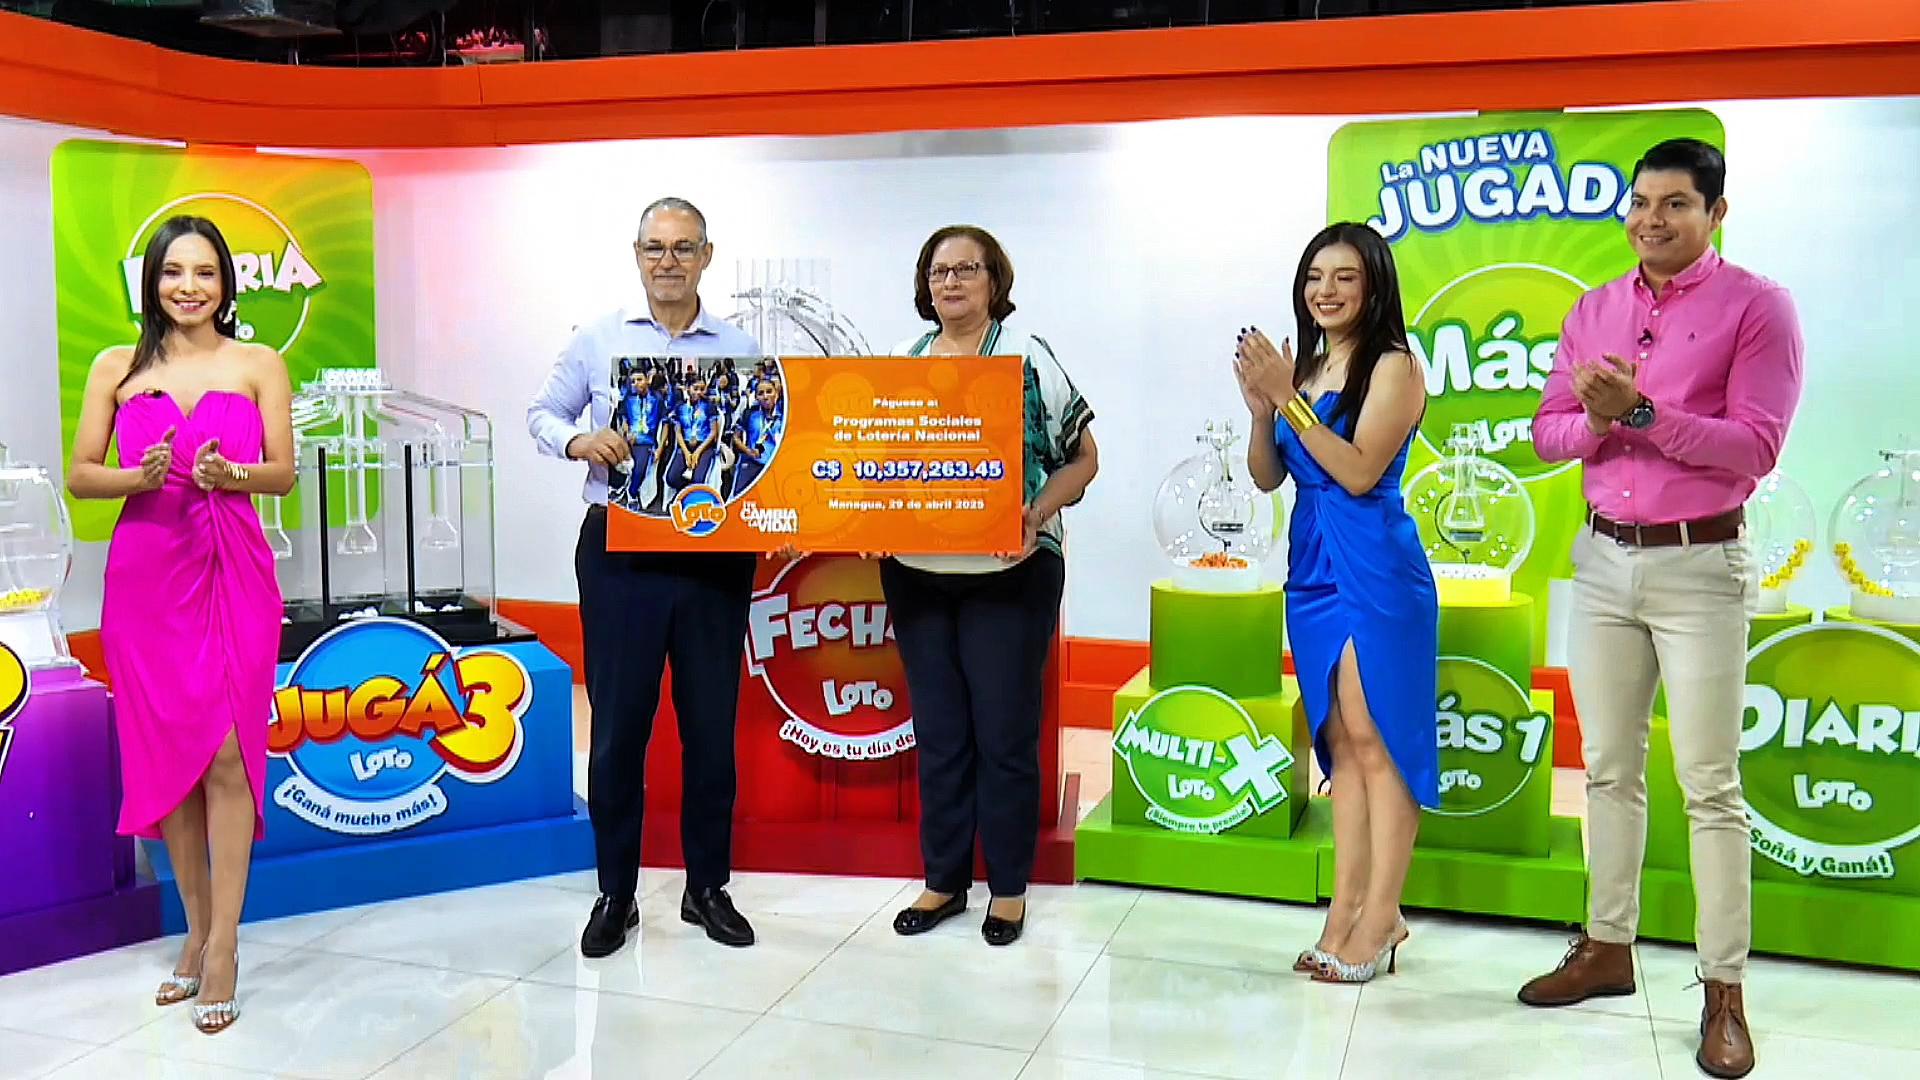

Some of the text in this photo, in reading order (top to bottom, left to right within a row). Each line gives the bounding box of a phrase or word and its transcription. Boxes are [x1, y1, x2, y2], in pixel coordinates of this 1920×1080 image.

[1381, 131, 1549, 183] La NUEVA
[873, 398, 925, 409] Páguese
[833, 415, 982, 430] Programas Sociales
[834, 430, 981, 442] de Lotería Nacional
[812, 460, 1003, 482] C$ 10,357,263.45
[828, 499, 984, 511] Managua, 29 de abril 2025
[266, 652, 526, 773] JUGÁ 3
[1737, 684, 1920, 758] DIARI
[1436, 695, 1546, 763] ás 1
[822, 742, 841, 755] es
[846, 744, 862, 756] tu
[867, 739, 892, 755] día
[895, 733, 914, 749] de
[283, 783, 438, 826] ¡Ganá mucho más!
[1198, 820, 1210, 831] te
[1803, 855, 1815, 870] y
[1821, 854, 1889, 874] Ganá!
